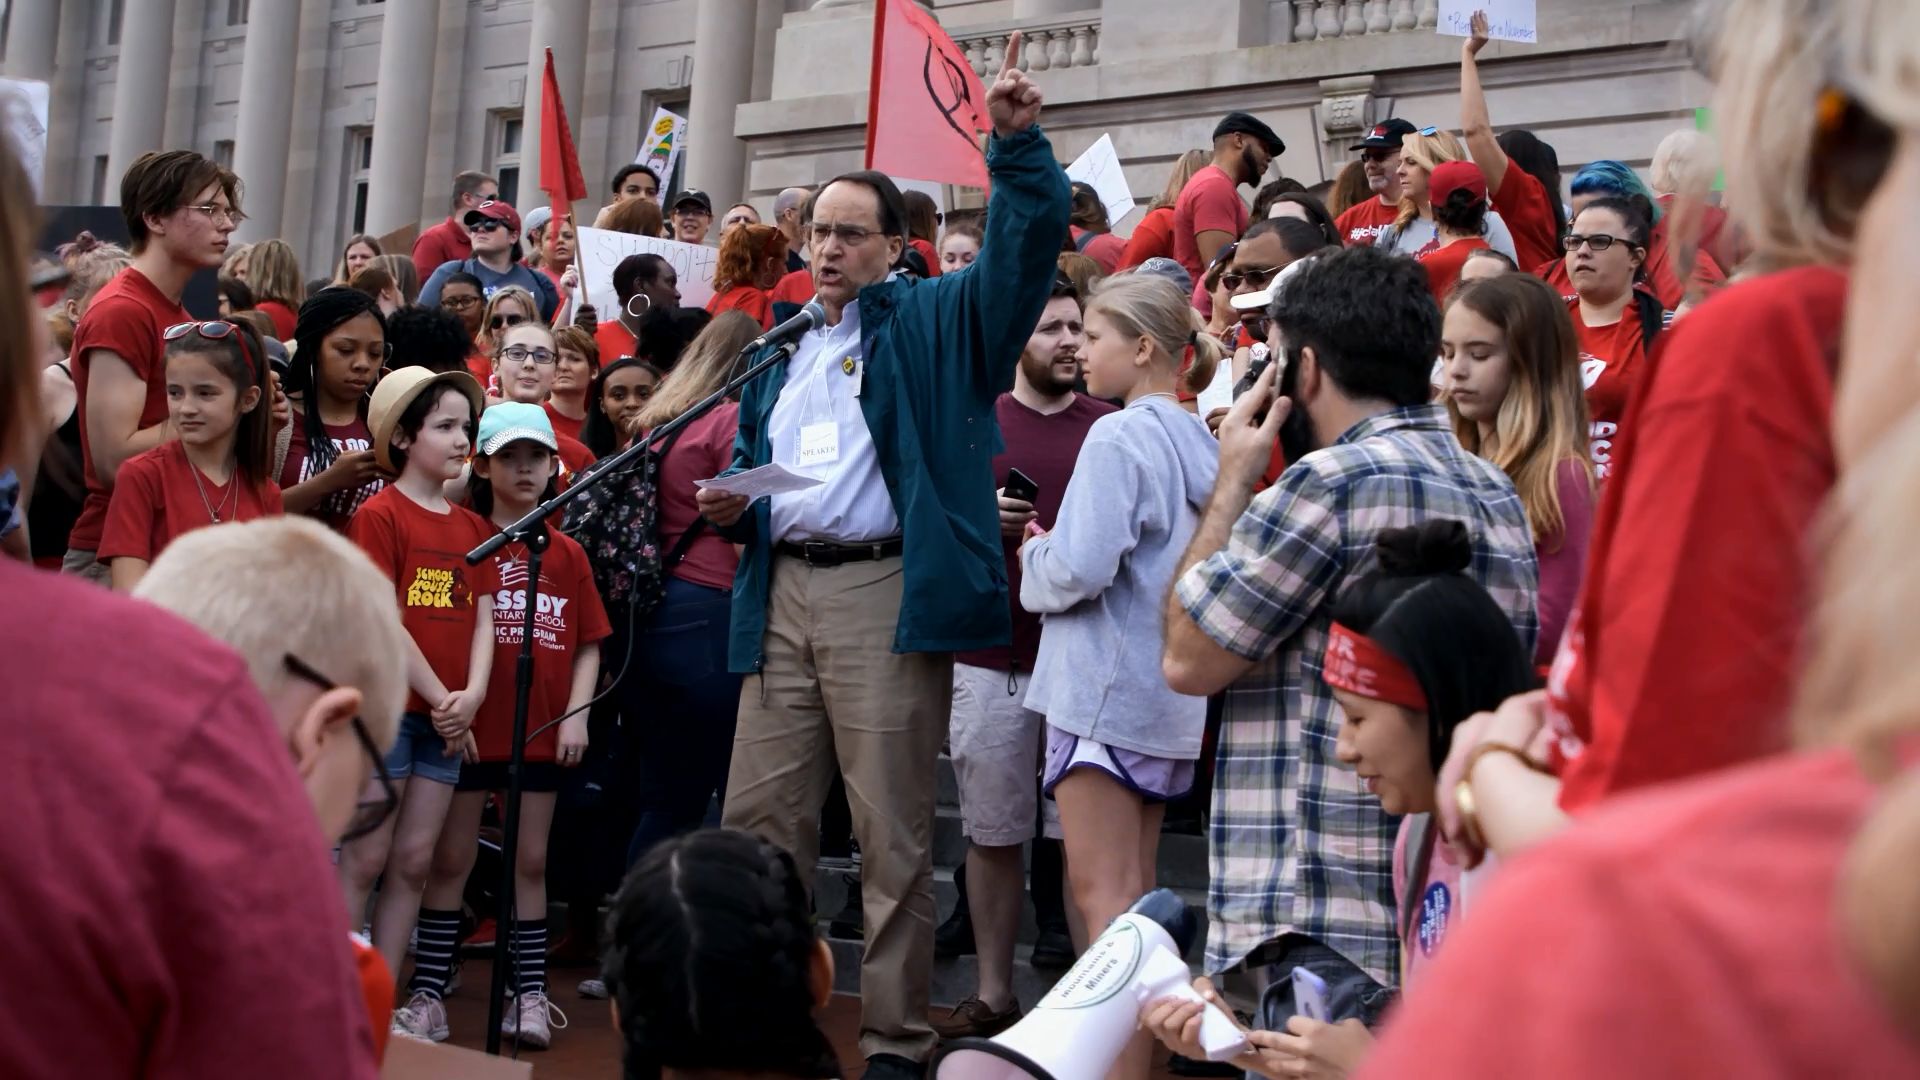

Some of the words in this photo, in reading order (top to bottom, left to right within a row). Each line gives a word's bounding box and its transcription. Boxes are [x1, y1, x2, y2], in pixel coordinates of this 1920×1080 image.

[802, 445, 837, 457] SPEAKER
[416, 567, 454, 582] SCHOOL
[407, 578, 455, 593] HOUSE
[407, 589, 454, 608] ROCK
[534, 612, 567, 628] CHOOL
[510, 626, 557, 643] PRGRAM
[1084, 958, 1119, 991] Miners
